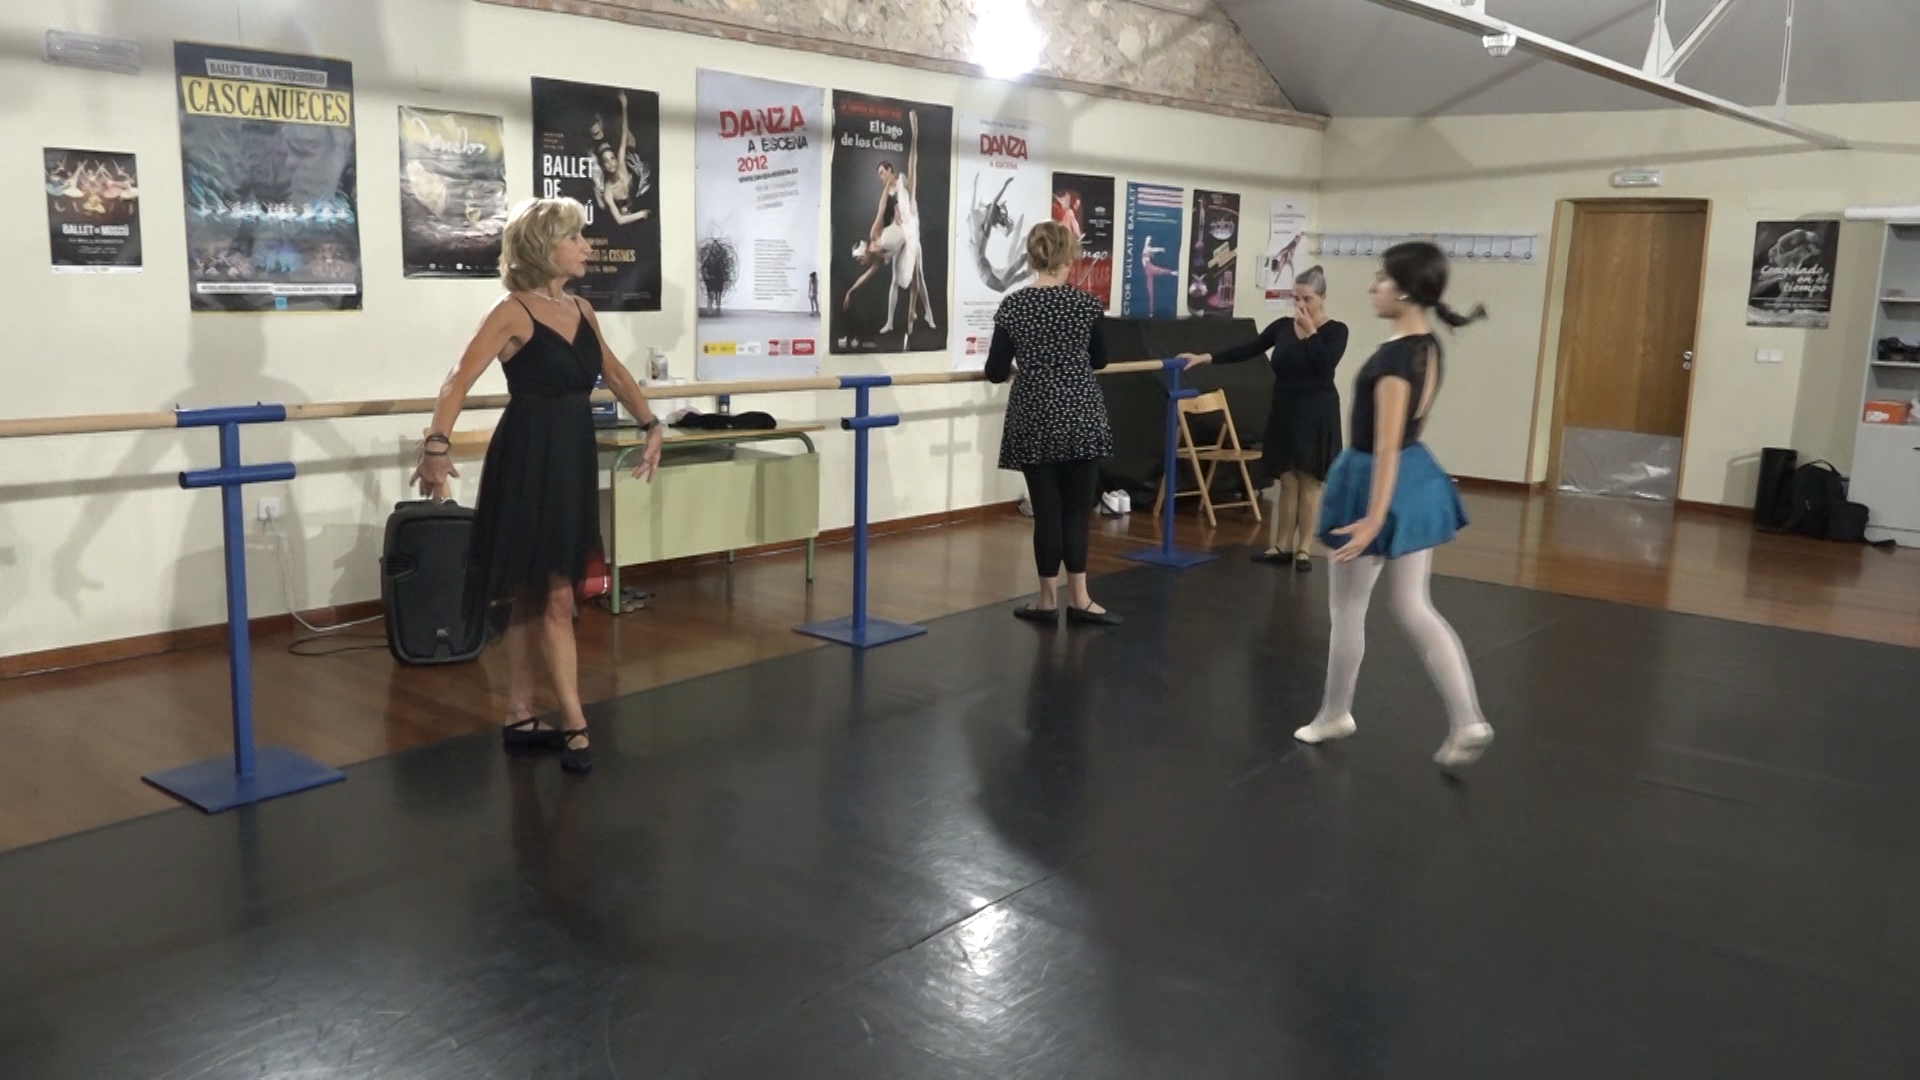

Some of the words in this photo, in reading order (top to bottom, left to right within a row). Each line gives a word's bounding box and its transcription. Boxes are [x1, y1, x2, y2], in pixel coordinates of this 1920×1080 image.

[210, 62, 240, 76] BALLET
[256, 66, 273, 79] SAN
[187, 79, 348, 125] CASCANUECES
[718, 105, 806, 139] DANZA
[869, 119, 880, 133] El
[881, 121, 904, 139] Lago
[748, 139, 757, 154] A
[761, 135, 809, 152] ESCENA
[840, 131, 853, 147] de
[855, 133, 871, 149] los
[872, 136, 904, 152] Cisnes
[980, 132, 1028, 161] DANZA
[543, 154, 593, 178] BALLET
[737, 155, 769, 173] 2012
[543, 178, 562, 199] DE
[1126, 185, 1136, 230] BALLET
